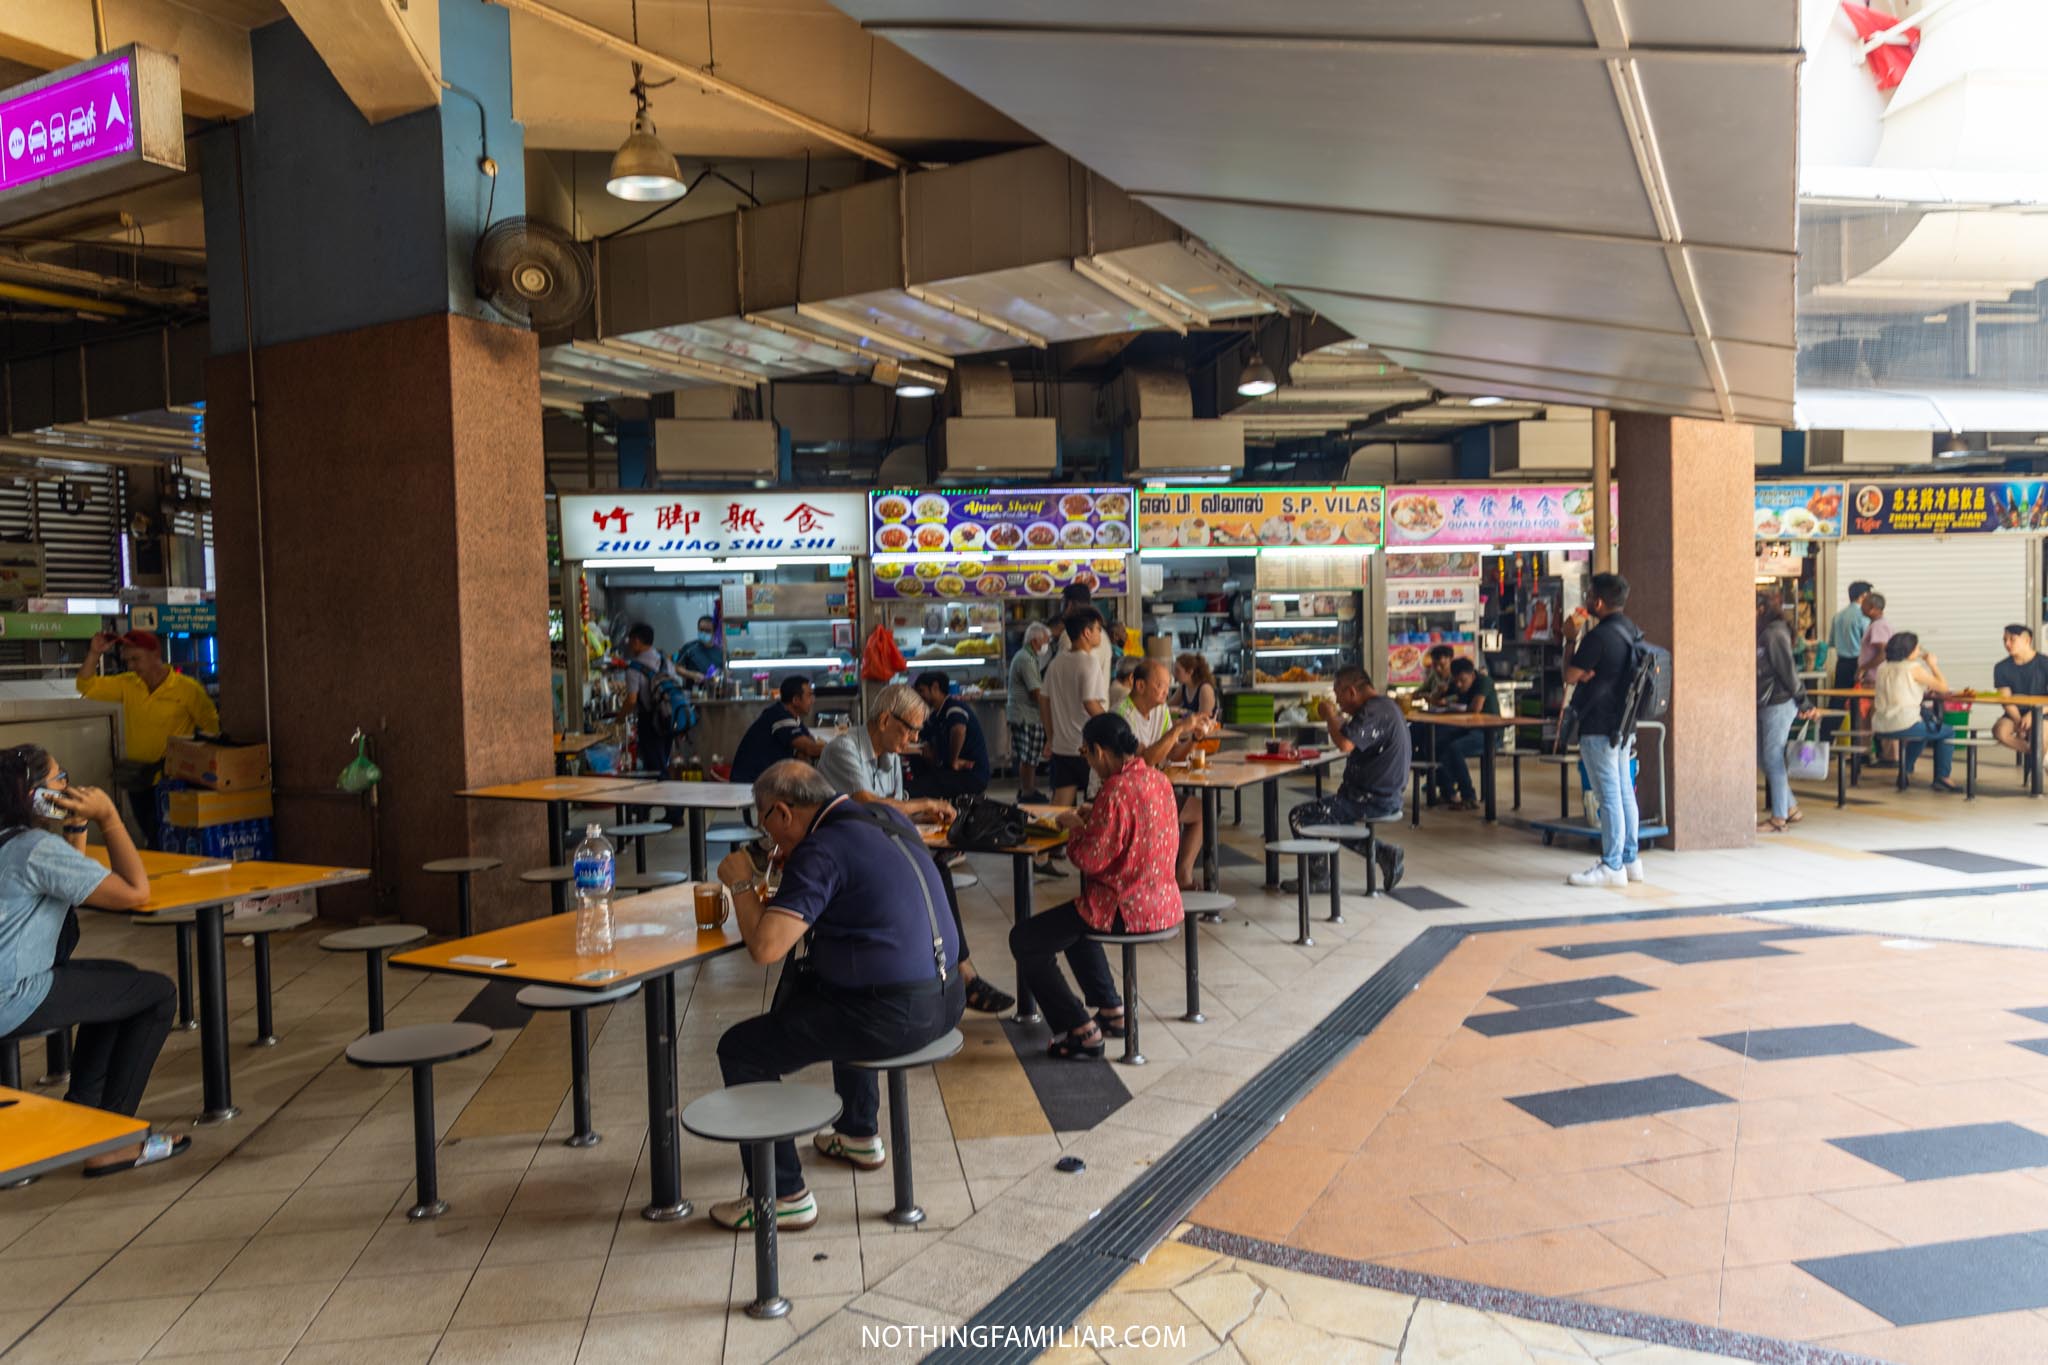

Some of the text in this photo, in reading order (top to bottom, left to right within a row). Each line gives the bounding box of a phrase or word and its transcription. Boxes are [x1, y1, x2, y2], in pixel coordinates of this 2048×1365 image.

[71, 136, 96, 152] DROP-OFF
[53, 146, 64, 157] MRT
[33, 153, 46, 164] TAXI
[1282, 496, 1381, 513] S.P. VILAS
[1888, 511, 1987, 523] ZHONG GUANG JIANG
[1448, 519, 1560, 530] QUAN FA COOKED FOOD
[1855, 517, 1882, 533] Tiger
[596, 541, 651, 552] ZHU
[658, 540, 720, 551] JIAO
[728, 539, 783, 550] SHU
[790, 538, 836, 549] SHI
[30, 623, 62, 631] HALAL
[220, 832, 257, 847] DASANI
